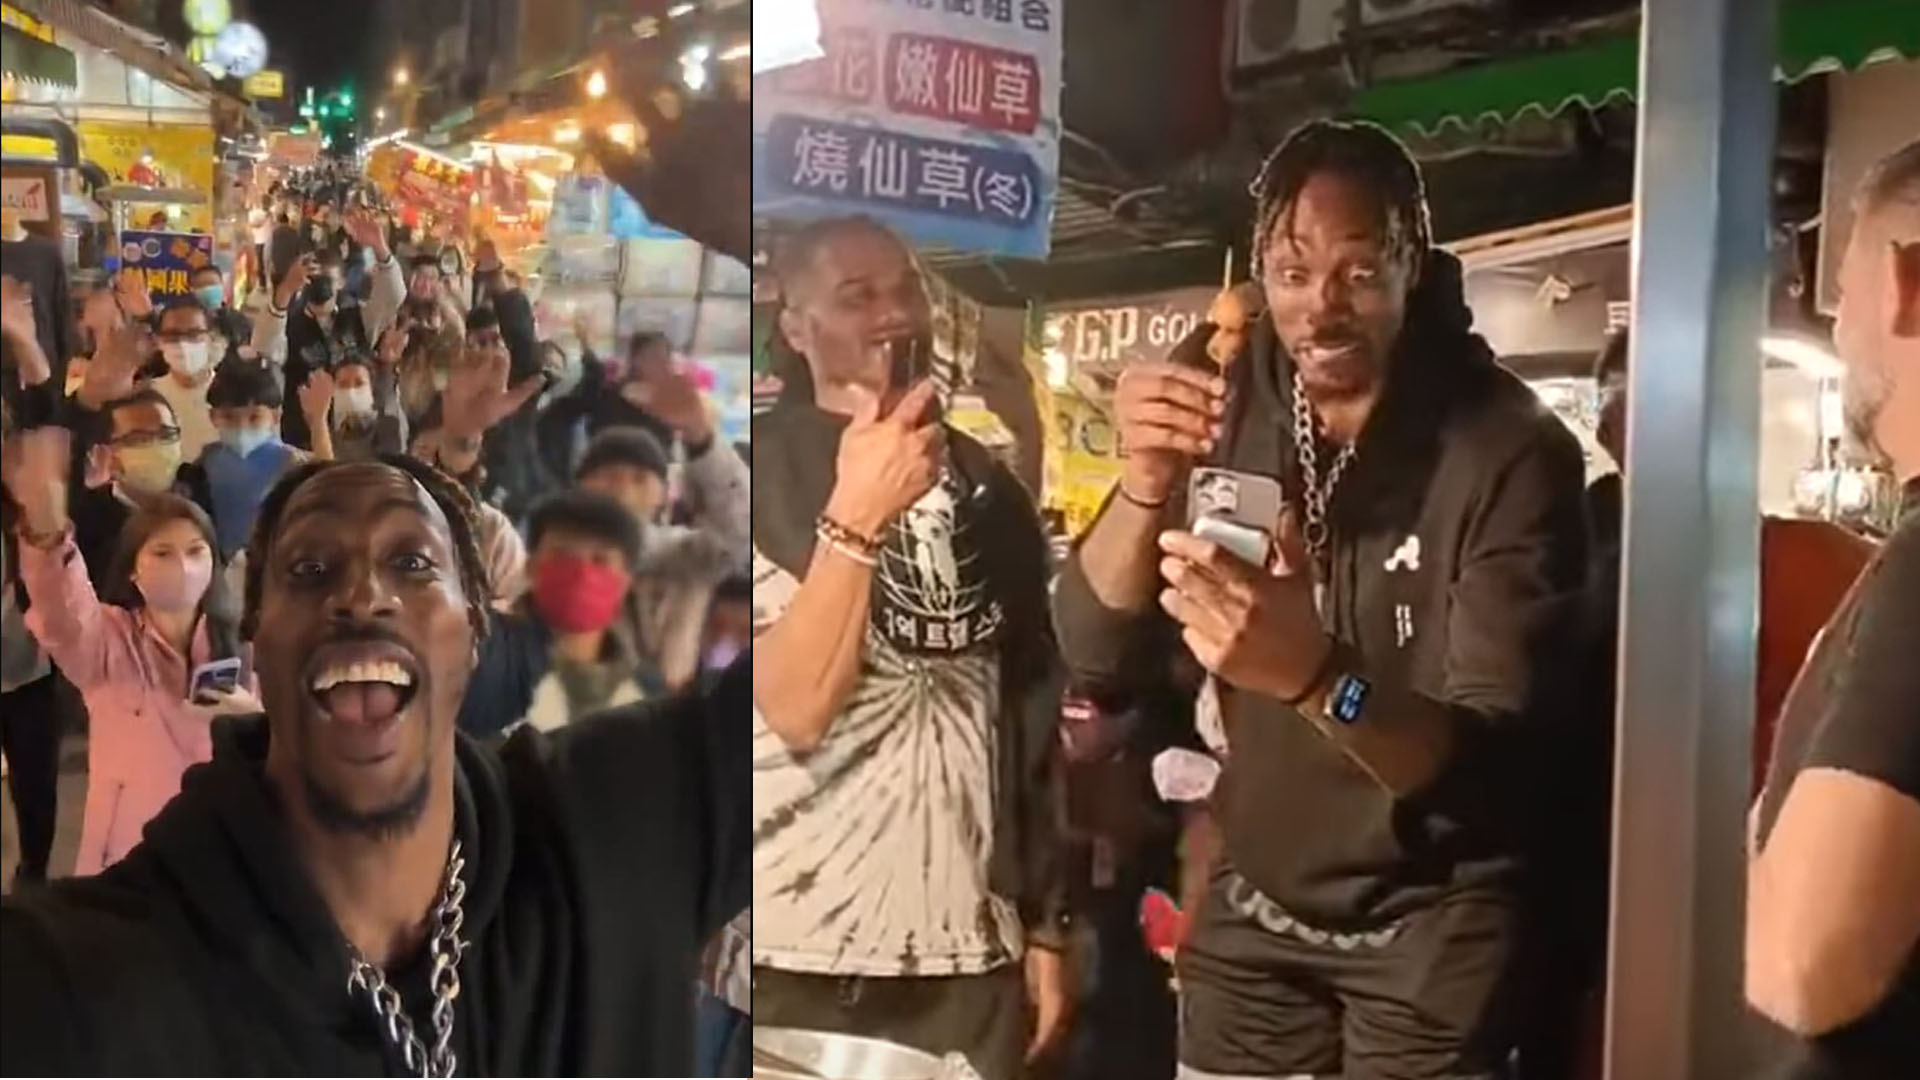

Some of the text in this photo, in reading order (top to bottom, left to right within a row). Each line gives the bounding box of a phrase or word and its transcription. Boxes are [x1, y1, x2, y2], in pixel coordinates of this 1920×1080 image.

[895, 40, 1031, 124] 嫩仙草
[792, 128, 1032, 219] 燒仙草(冬)
